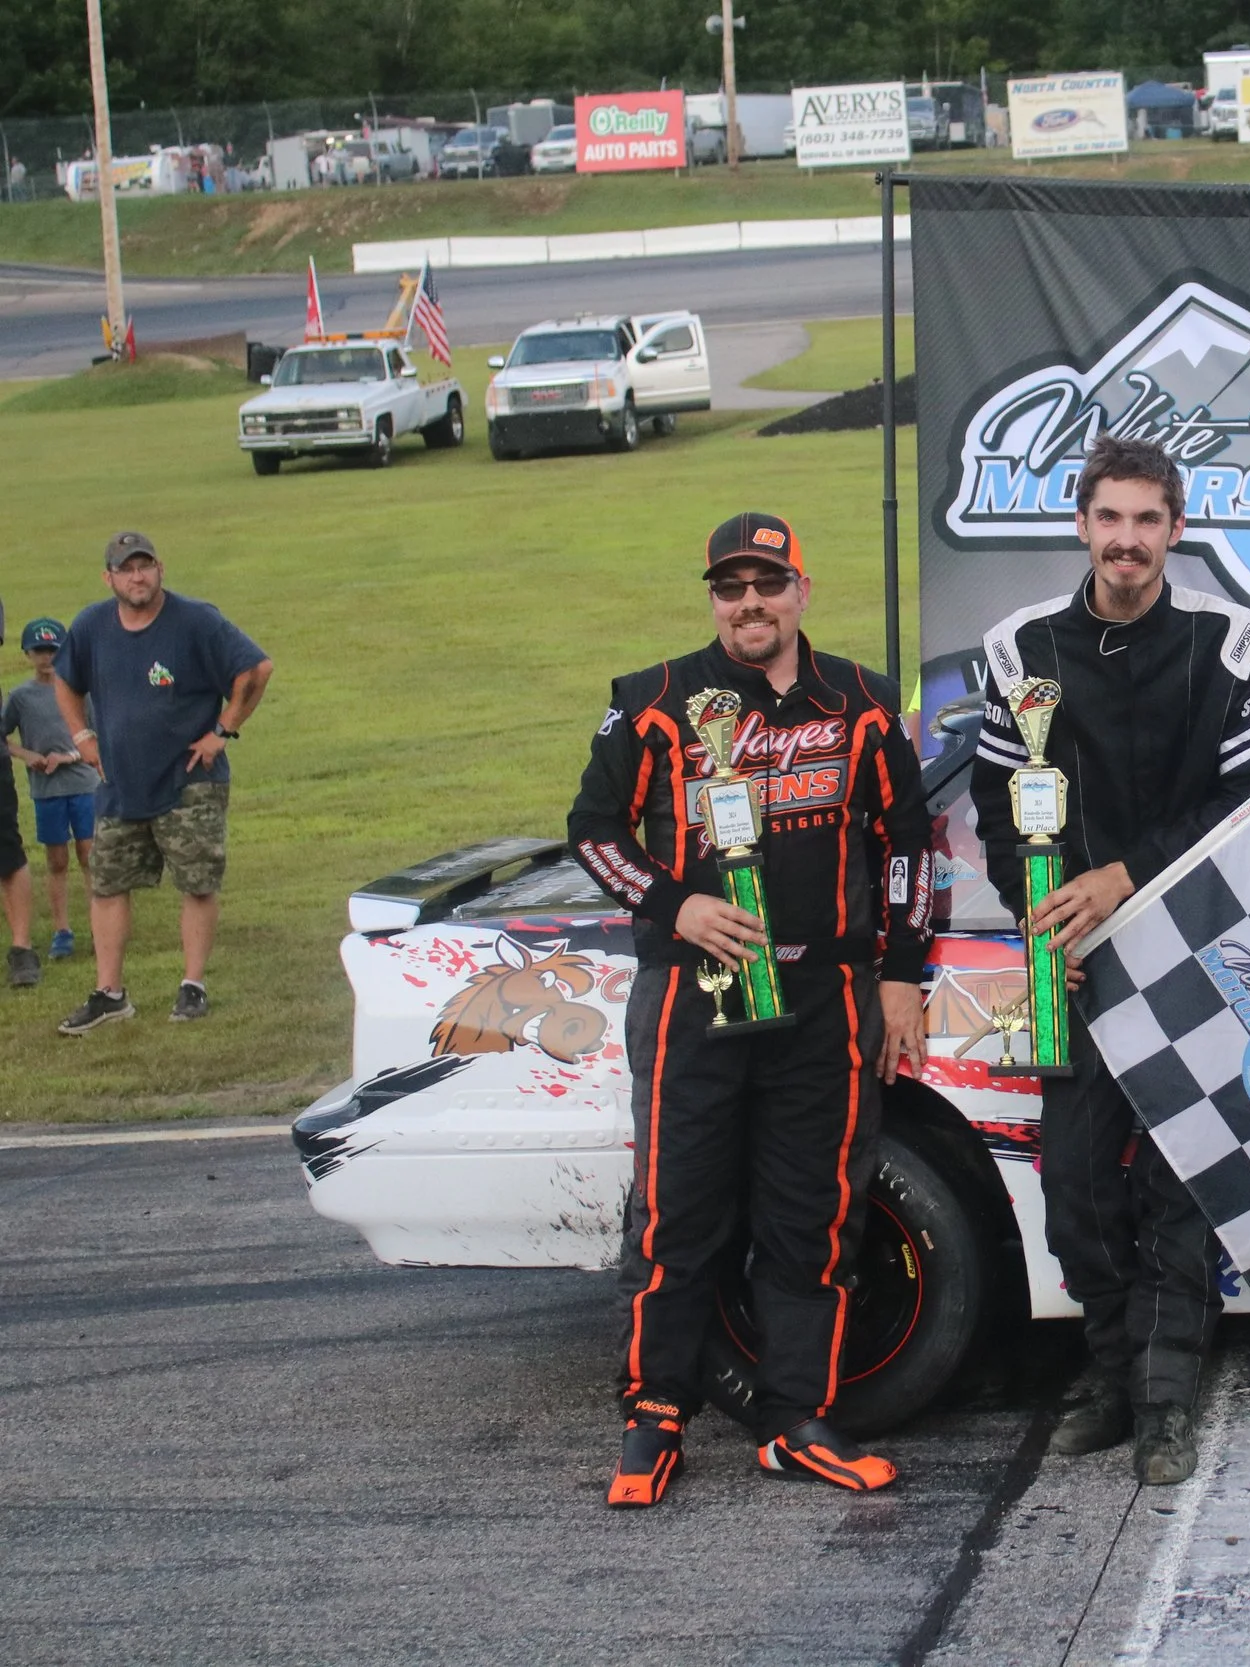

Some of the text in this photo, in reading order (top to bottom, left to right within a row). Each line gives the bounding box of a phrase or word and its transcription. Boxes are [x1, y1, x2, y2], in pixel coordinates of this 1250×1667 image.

[799, 90, 902, 127] AVERY'S
[590, 105, 668, 136] O'Reilly
[584, 139, 678, 161] AUTO PARTS
[800, 132, 835, 147] (603)
[994, 642, 1015, 675] SIMPSON
[1036, 824, 1057, 832] Place
[735, 835, 755, 844] Place
